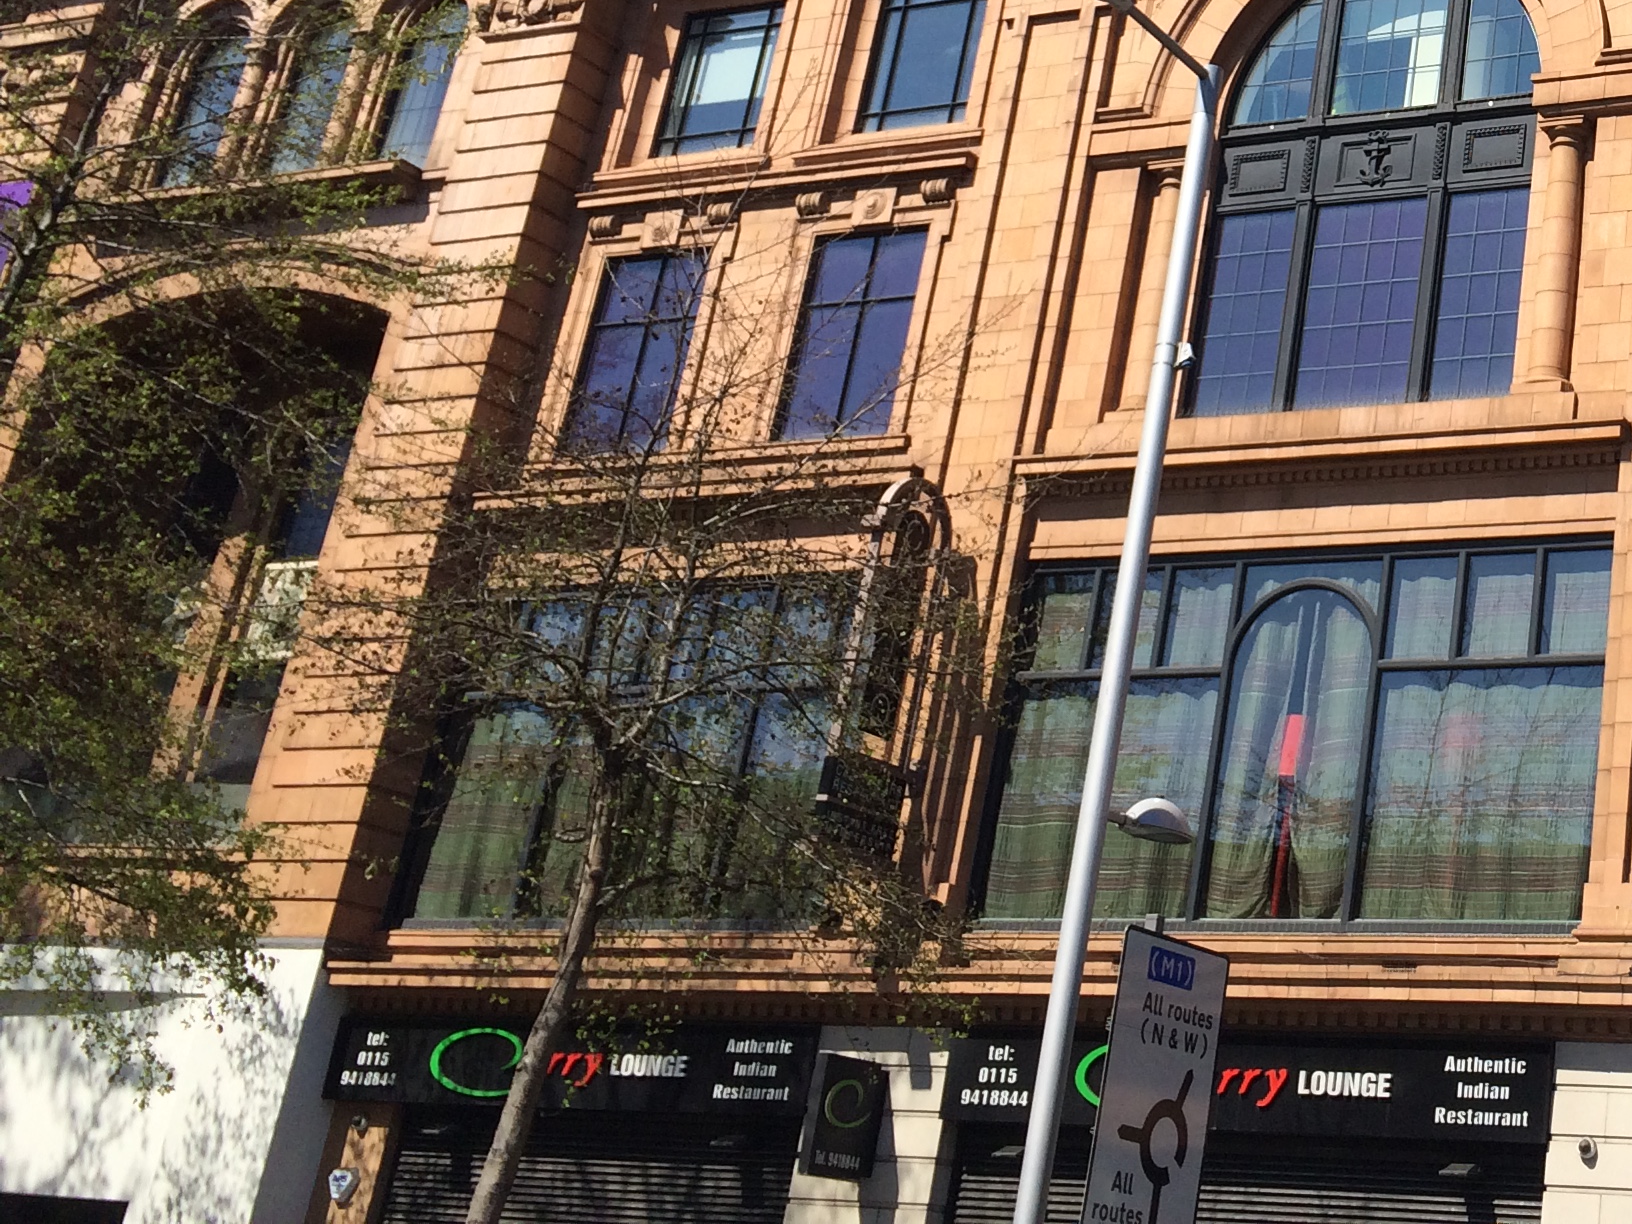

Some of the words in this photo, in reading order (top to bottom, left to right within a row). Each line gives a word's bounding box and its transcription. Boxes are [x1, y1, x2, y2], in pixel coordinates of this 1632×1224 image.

[1151, 950, 1192, 986] (M1)
[1142, 991, 1164, 1017] All
[1167, 1003, 1213, 1030] routes
[366, 1031, 390, 1046] tel:
[726, 1038, 794, 1055] Authentic
[357, 1051, 391, 1066] 0115
[988, 1045, 1015, 1061] tel:
[429, 1028, 603, 1098] Crry
[610, 1053, 690, 1077] LOUNGE
[733, 1061, 777, 1077] Indian
[1444, 1055, 1527, 1074] Authentic
[340, 1070, 397, 1087] 9418844
[978, 1067, 1018, 1084] 0115
[1297, 1070, 1393, 1098] LOUNGE
[712, 1084, 790, 1101] Restaurant
[960, 1089, 1029, 1106] 9418844
[1457, 1081, 1510, 1100] Indian
[1434, 1106, 1529, 1127] Restaurant
[1111, 1170, 1134, 1195] All
[1091, 1202, 1143, 1224] routes
